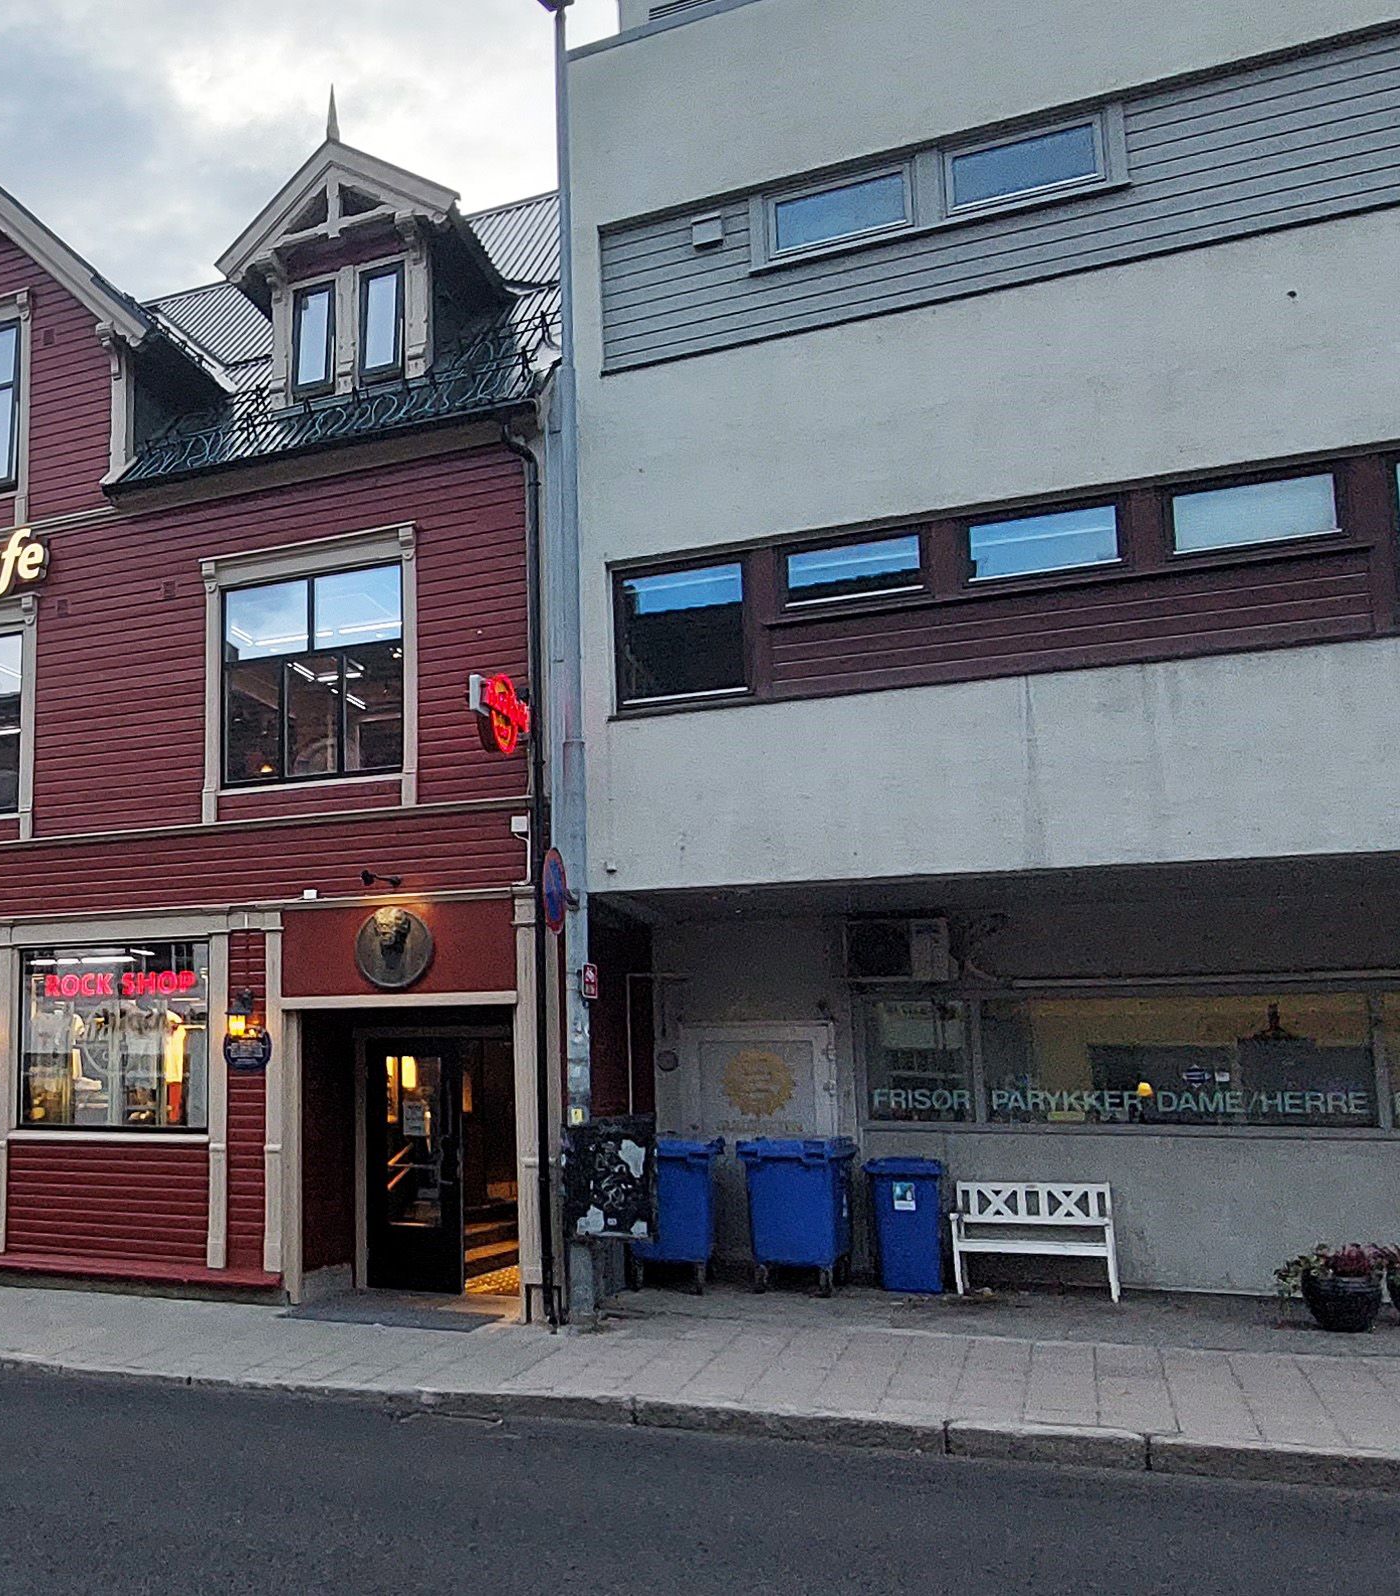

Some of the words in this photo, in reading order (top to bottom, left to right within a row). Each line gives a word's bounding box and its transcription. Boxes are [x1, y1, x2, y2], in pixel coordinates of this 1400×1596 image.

[44, 972, 114, 997] ROCK
[121, 970, 197, 996] SHOP
[873, 1088, 970, 1110] FRISØR
[991, 1089, 1143, 1112] PARYKKER
